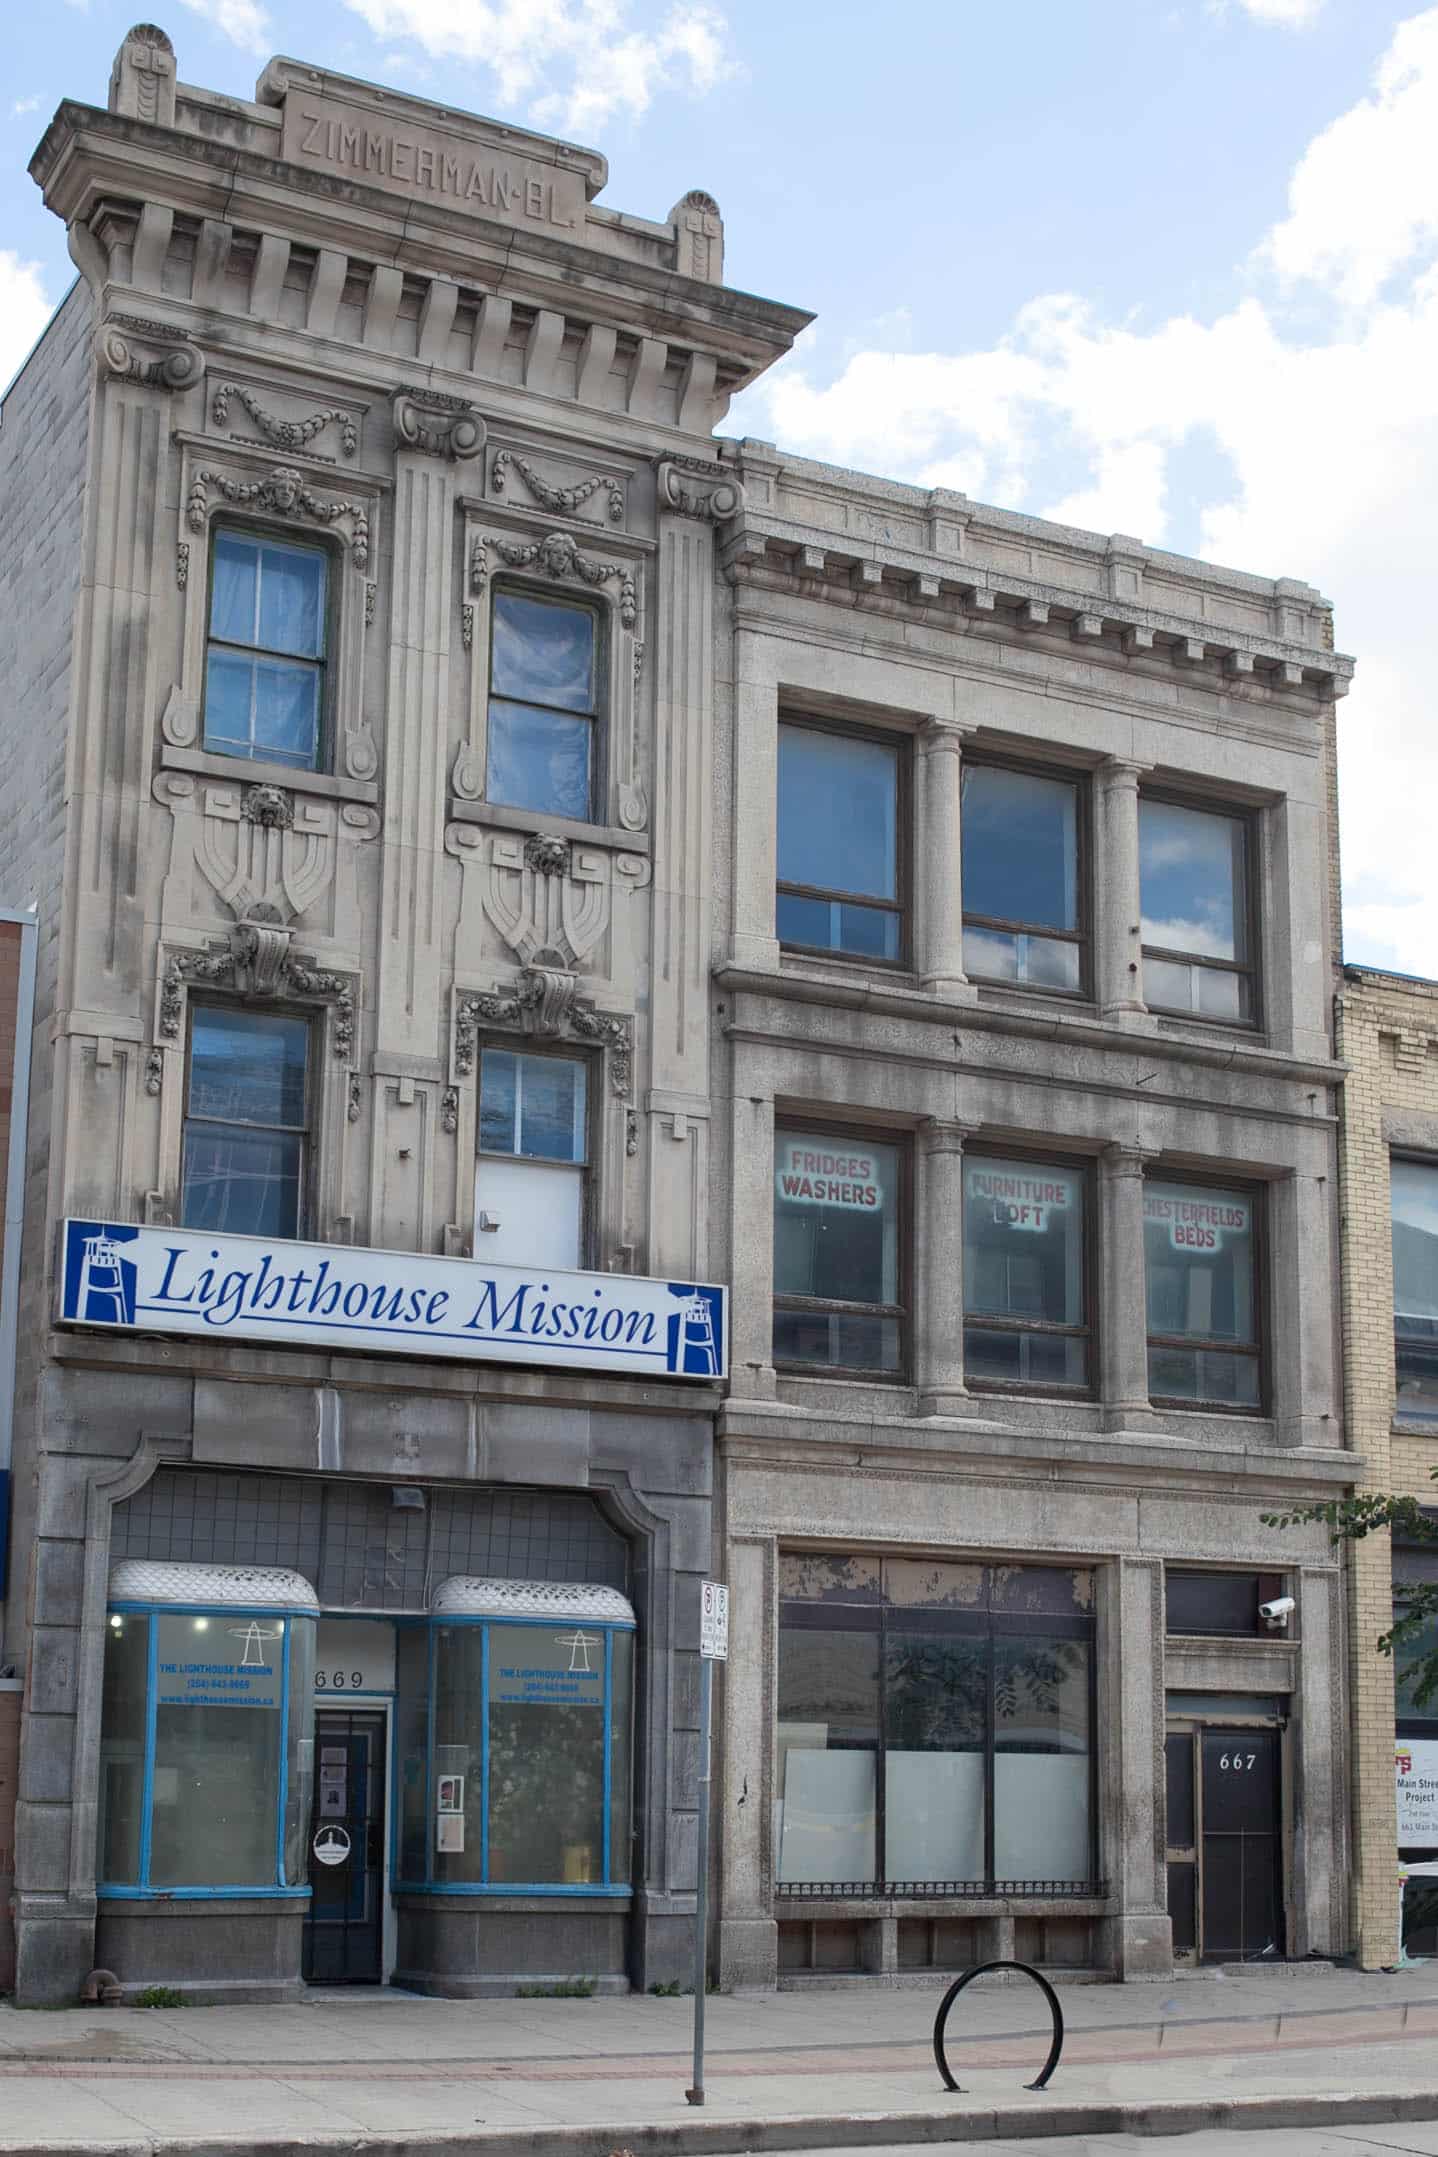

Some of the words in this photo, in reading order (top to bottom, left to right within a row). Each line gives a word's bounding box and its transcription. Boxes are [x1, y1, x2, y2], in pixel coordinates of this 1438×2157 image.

[791, 1150, 871, 1179] FRIDGES
[782, 1175, 877, 1206] WASHERS
[972, 1173, 1066, 1204] FURNITURE
[1175, 1225, 1216, 1247] BEDS
[150, 1246, 451, 1327] Lighthouse
[461, 1279, 660, 1346] Mission
[159, 1663, 177, 1673] THE
[315, 1671, 362, 1688] 669
[1219, 1753, 1256, 1770] 667
[1397, 1778, 1417, 1789] Main
[1405, 1791, 1435, 1804] Project
